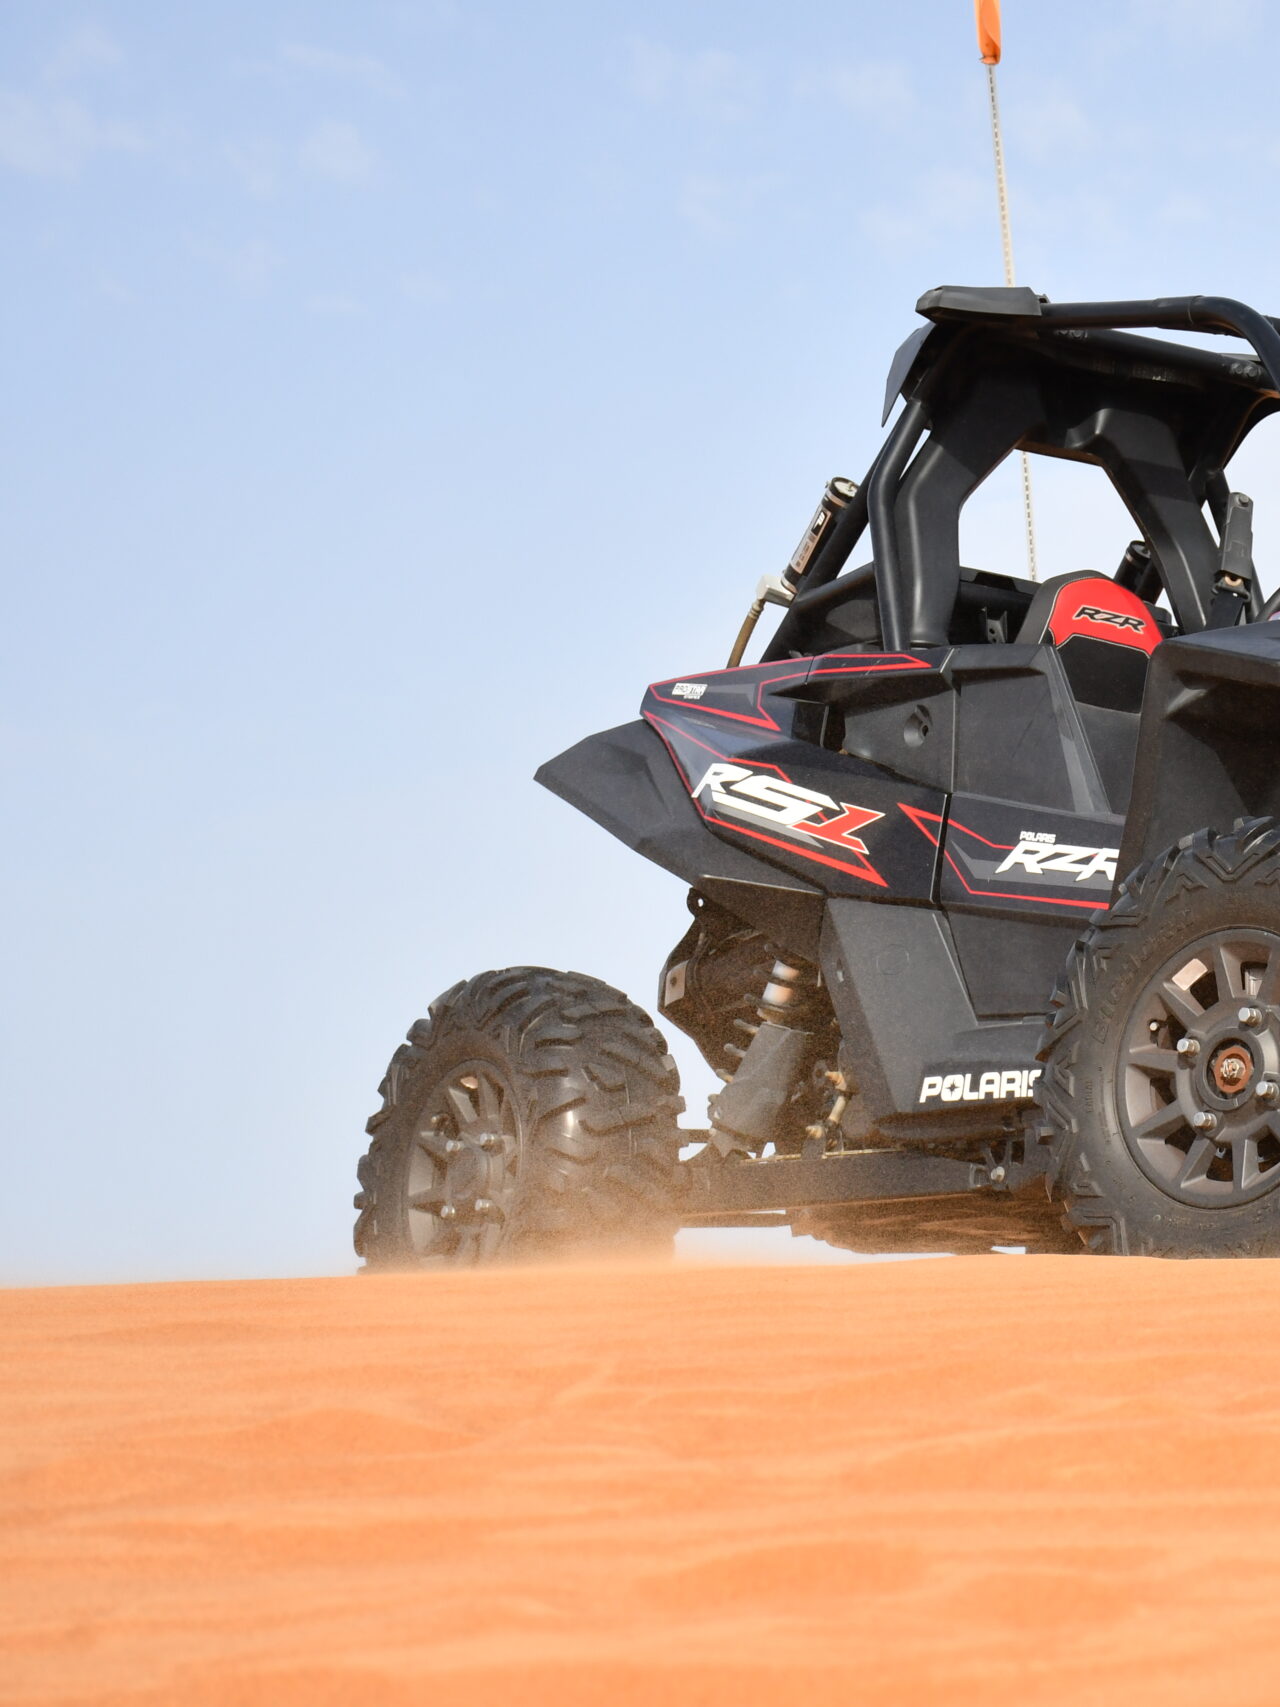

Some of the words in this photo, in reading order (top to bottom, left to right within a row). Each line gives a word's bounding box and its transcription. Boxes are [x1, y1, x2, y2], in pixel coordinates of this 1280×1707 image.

[1072, 605, 1146, 634] RZR
[690, 762, 887, 855] RS1
[1020, 831, 1056, 844] POLARIS
